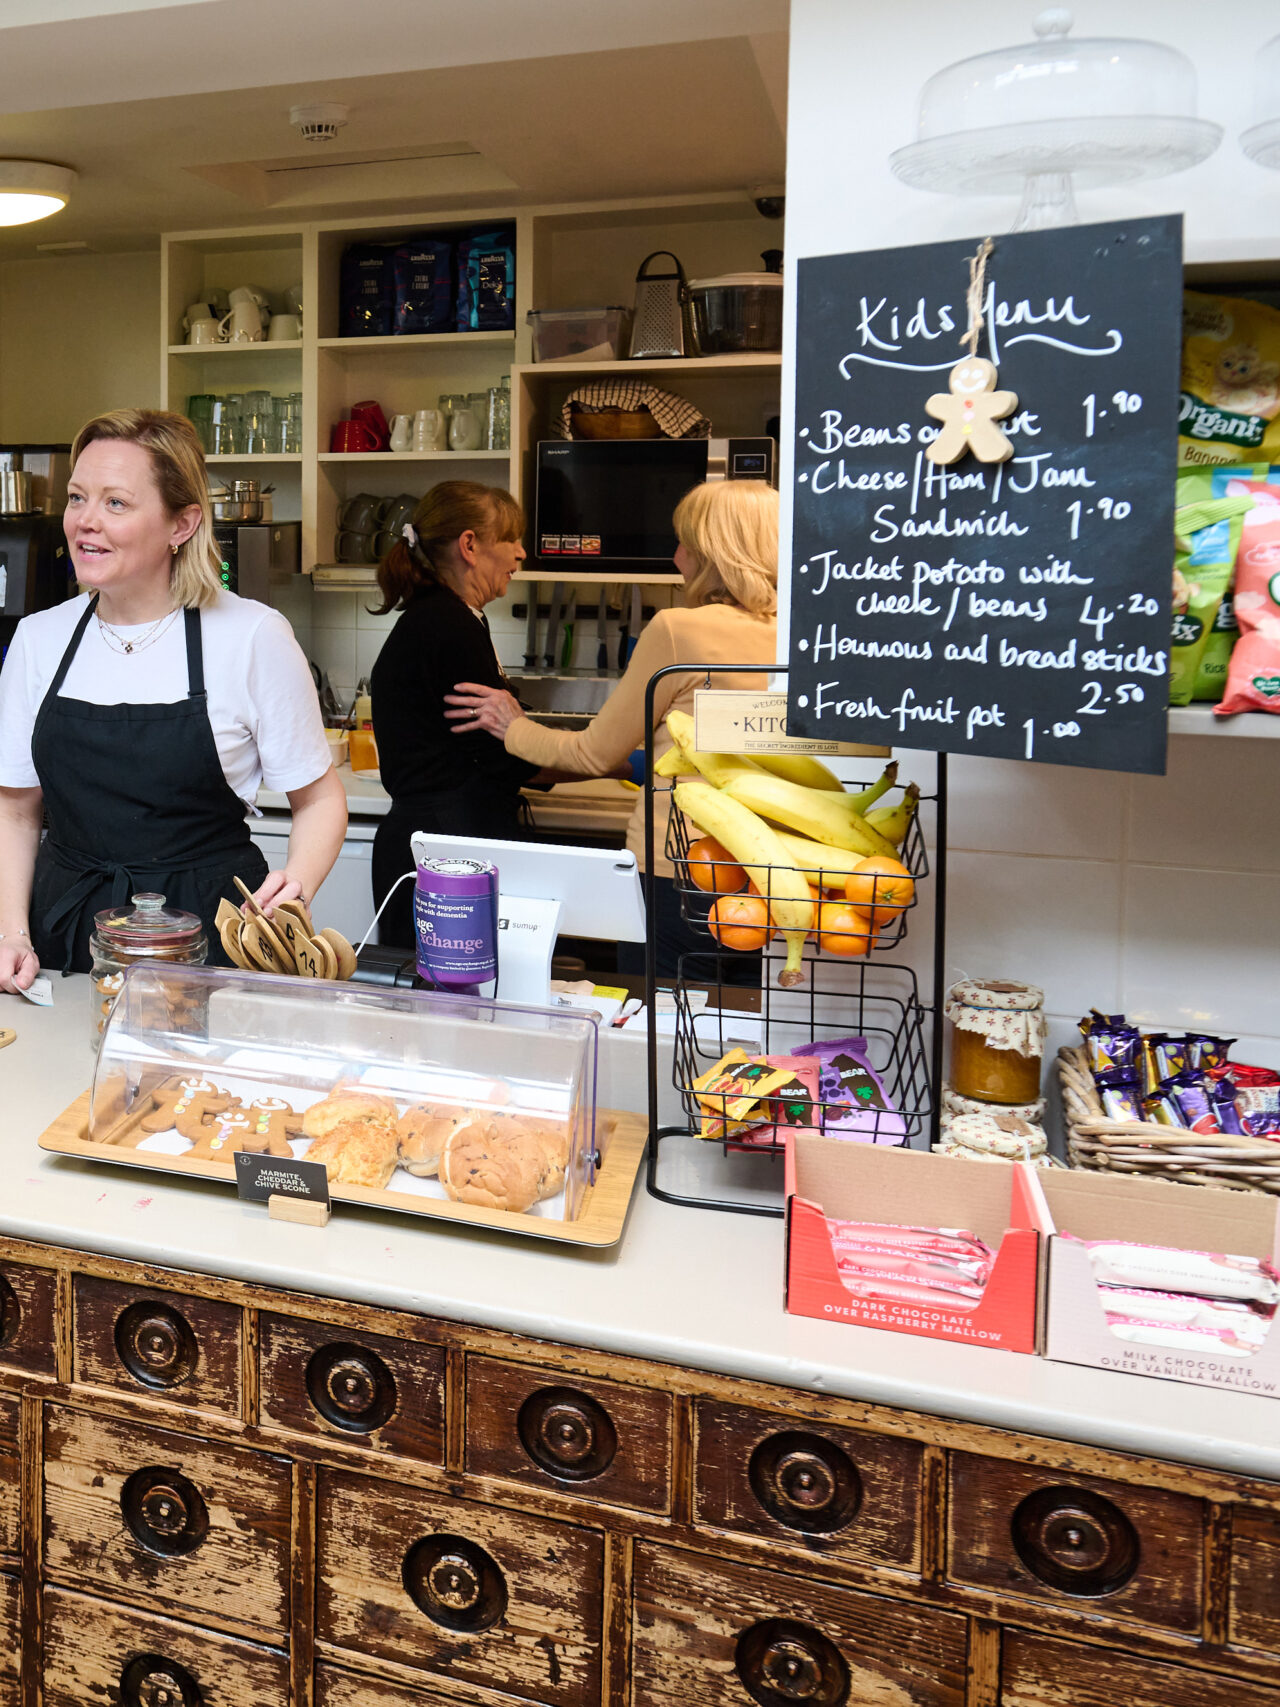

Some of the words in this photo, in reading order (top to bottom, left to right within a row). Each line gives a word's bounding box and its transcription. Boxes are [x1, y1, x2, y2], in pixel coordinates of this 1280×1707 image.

[856, 297, 955, 351] Kids
[808, 410, 911, 454] Beans
[1082, 391, 1142, 438] 1.90
[869, 503, 1029, 544] Sandwich
[1066, 498, 1131, 540] 1.90
[809, 550, 904, 595] Jacket
[913, 558, 1005, 606] potato
[1019, 554, 1094, 585] with
[1079, 593, 1159, 641] 4.20
[813, 623, 932, 664] Houmous
[944, 634, 988, 665] and
[999, 638, 1076, 670] bread
[1081, 643, 1168, 677] sticks
[1076, 681, 1145, 715] 2.50
[813, 680, 890, 720] Fresh
[891, 687, 961, 732] fruit
[967, 703, 1006, 740] pot
[1022, 718, 1081, 760] 1.00
[436, 911, 467, 919] dementia
[437, 903, 474, 912] supporting
[840, 1068, 867, 1078] BEAR
[780, 1088, 807, 1096] BEAR
[255, 1180, 280, 1189] CHIVE
[282, 1185, 310, 1194] SCONE
[258, 1175, 298, 1186] CHEDDAR
[823, 1304, 858, 1318] OVER
[863, 1311, 937, 1331] RASPBERRY
[942, 1324, 1002, 1342] MALLOW
[851, 1299, 886, 1313] DARK
[891, 1306, 973, 1327] CHOCOLATE
[1100, 1356, 1138, 1370] OVER
[1144, 1363, 1205, 1381] VANILLA
[1211, 1374, 1276, 1392] MALLOW
[1123, 1350, 1157, 1362] MILK
[1164, 1356, 1253, 1377] CHOCOLATE
